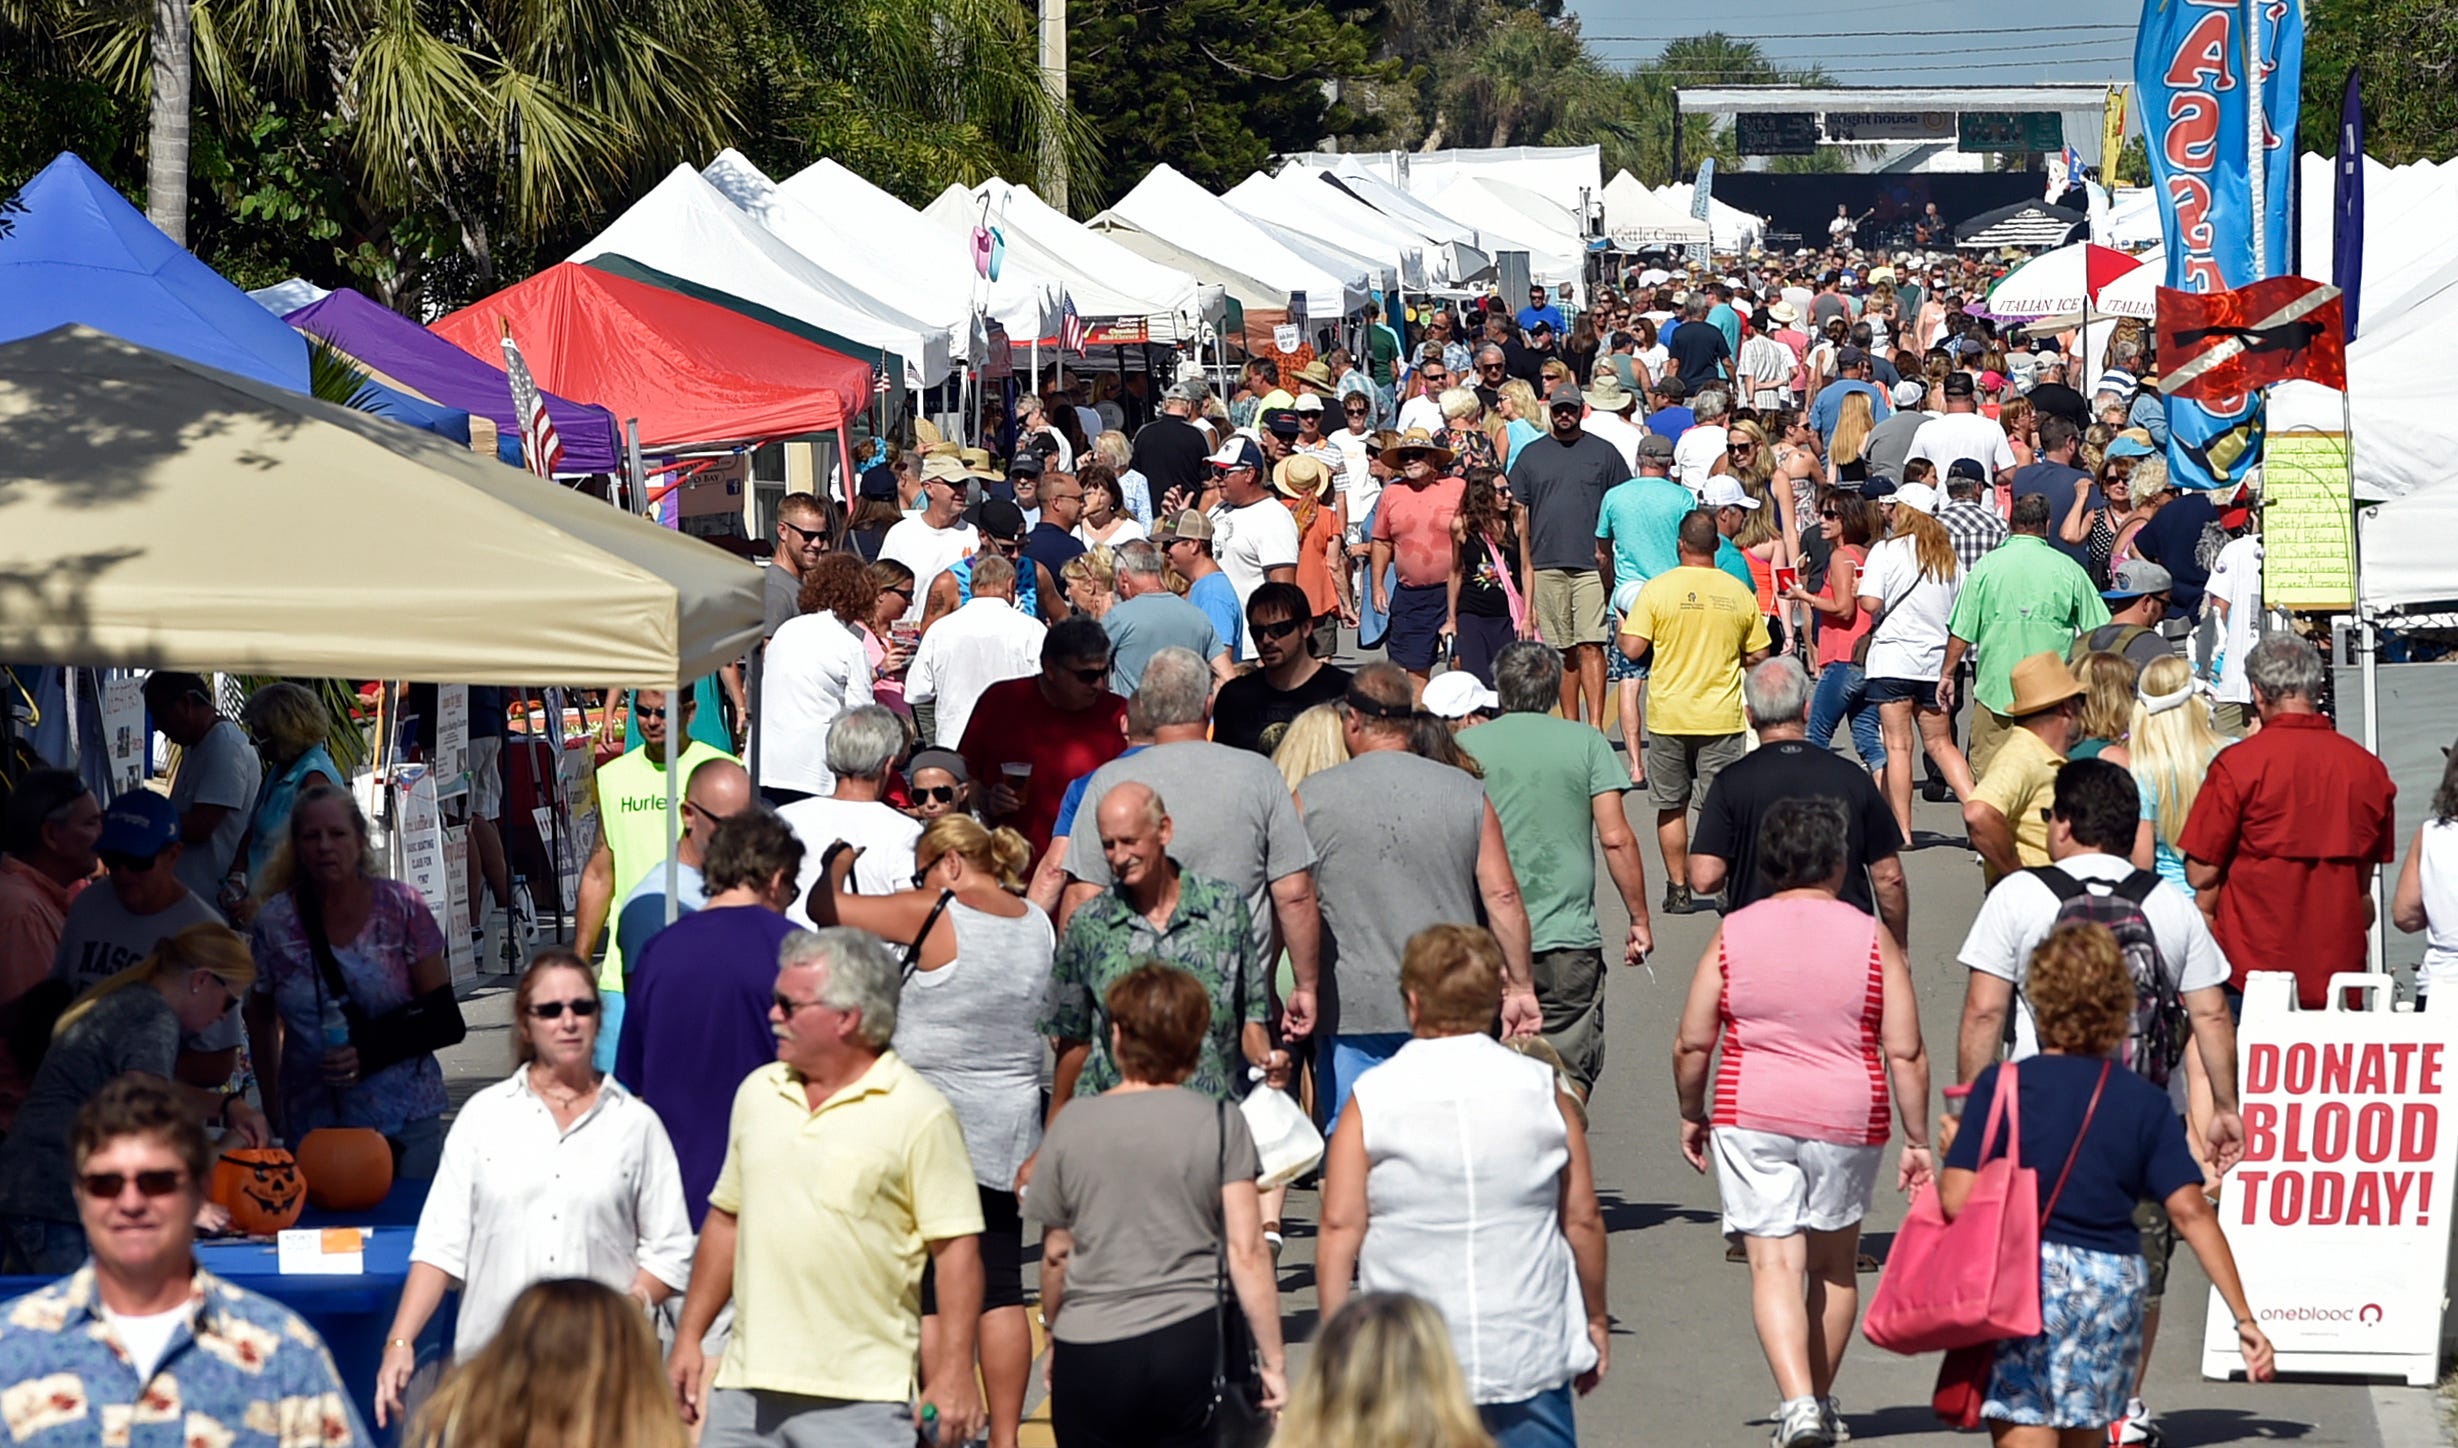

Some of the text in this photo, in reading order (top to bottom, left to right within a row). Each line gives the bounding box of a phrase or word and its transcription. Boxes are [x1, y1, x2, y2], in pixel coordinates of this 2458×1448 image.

[1874, 112, 1918, 124] house
[1611, 227, 1689, 241] Kettle Corn
[1999, 298, 2080, 313] ITALIAN ICE
[2105, 299, 2156, 314] ITALIAN
[621, 794, 679, 813] Hurle
[2246, 1042, 2444, 1094] DONATE
[2243, 1101, 2438, 1163] BLOOD
[2237, 1170, 2434, 1226] TODAY!
